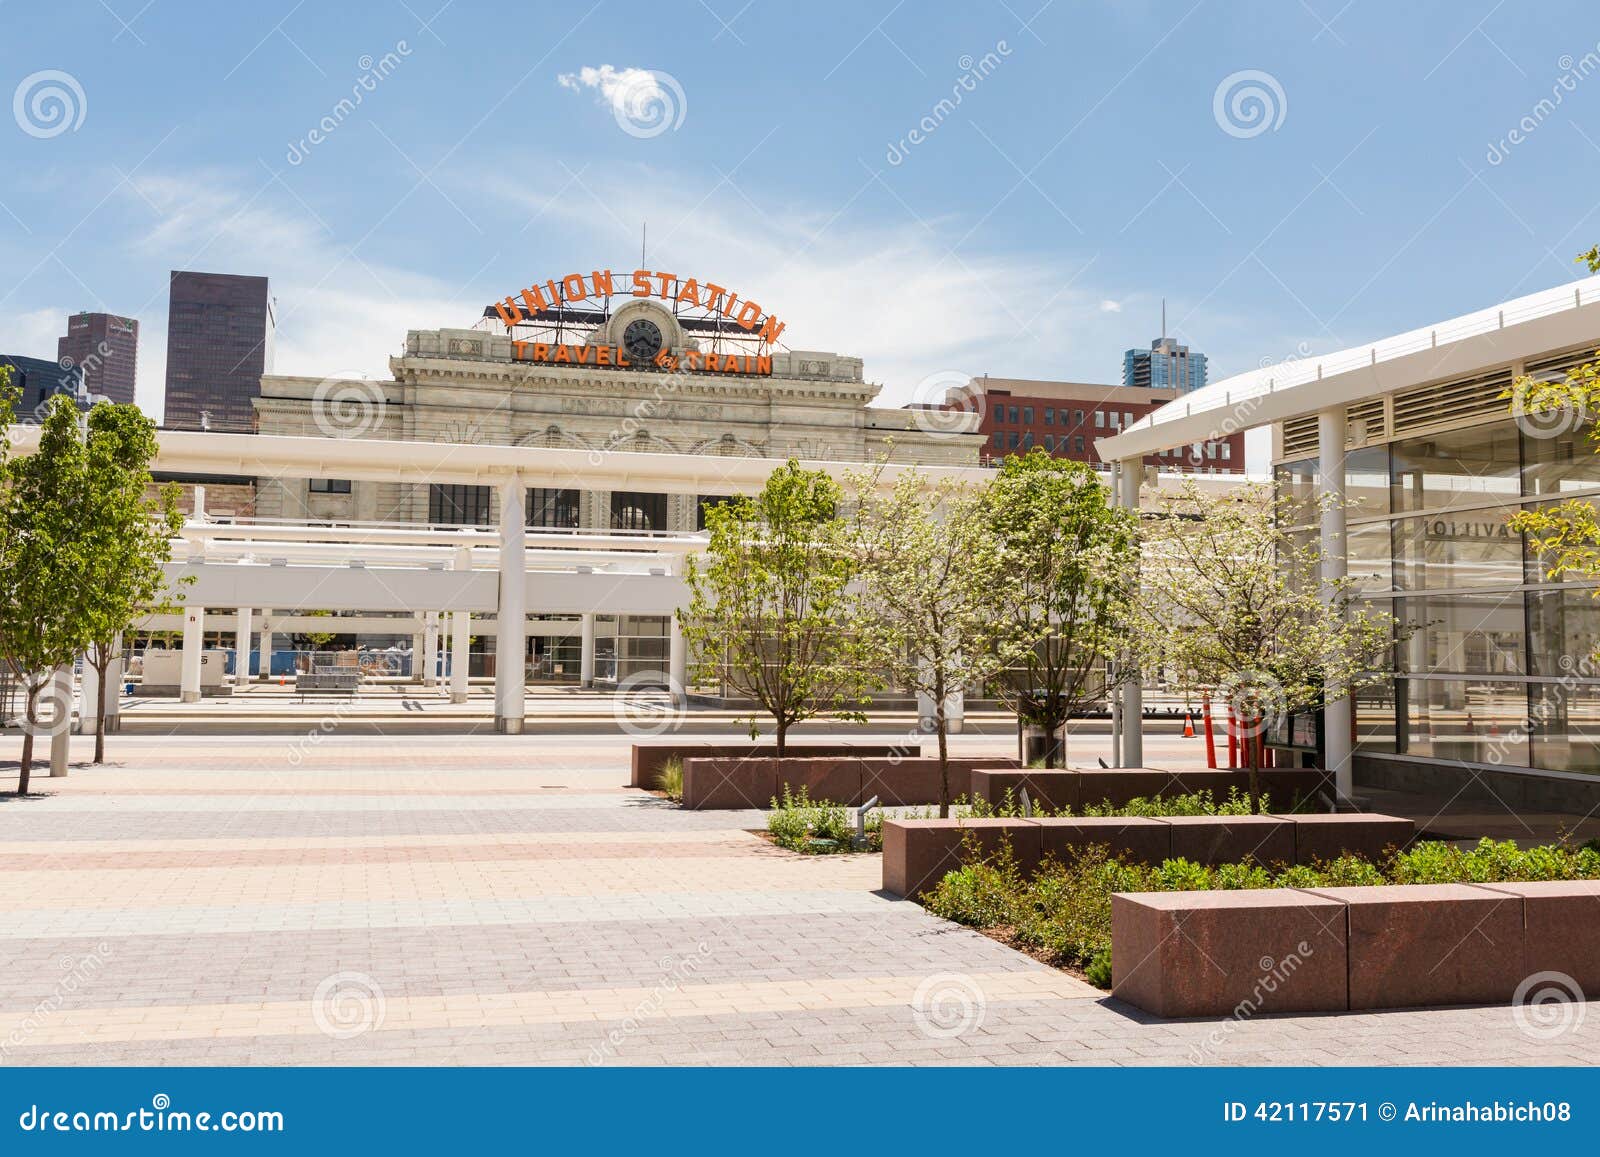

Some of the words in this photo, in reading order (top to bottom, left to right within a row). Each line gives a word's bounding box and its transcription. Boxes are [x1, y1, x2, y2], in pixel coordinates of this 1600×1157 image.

[494, 269, 613, 327] UNION
[631, 269, 786, 345] STATION
[512, 340, 631, 367] TRAVEL
[685, 350, 773, 375] TRAIN
